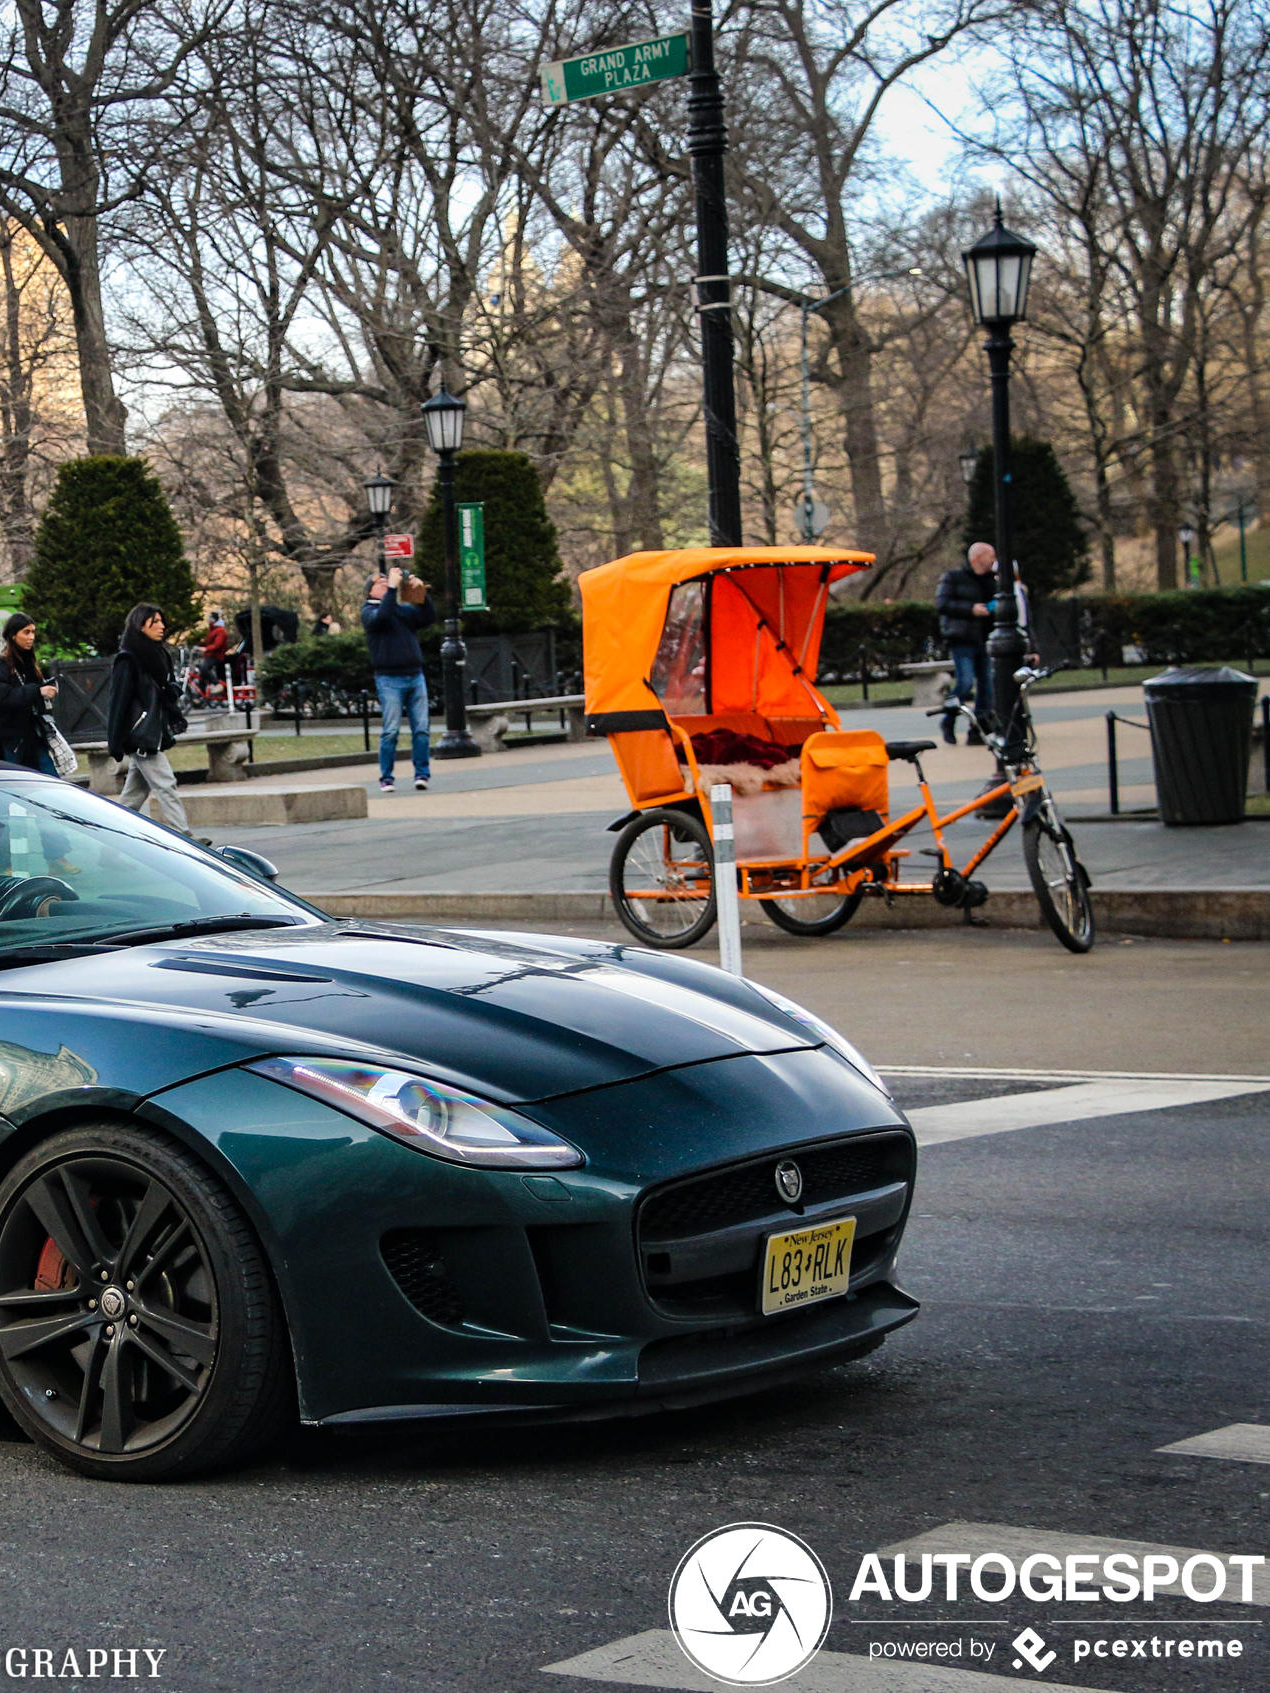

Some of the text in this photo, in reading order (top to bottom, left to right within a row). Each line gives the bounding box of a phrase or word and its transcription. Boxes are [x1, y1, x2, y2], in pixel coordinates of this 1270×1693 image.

[581, 40, 670, 76] GRAND ARMY
[605, 63, 651, 87] PLAZA
[789, 1229, 834, 1247] New Jersey
[785, 1284, 828, 1303] Garden State
